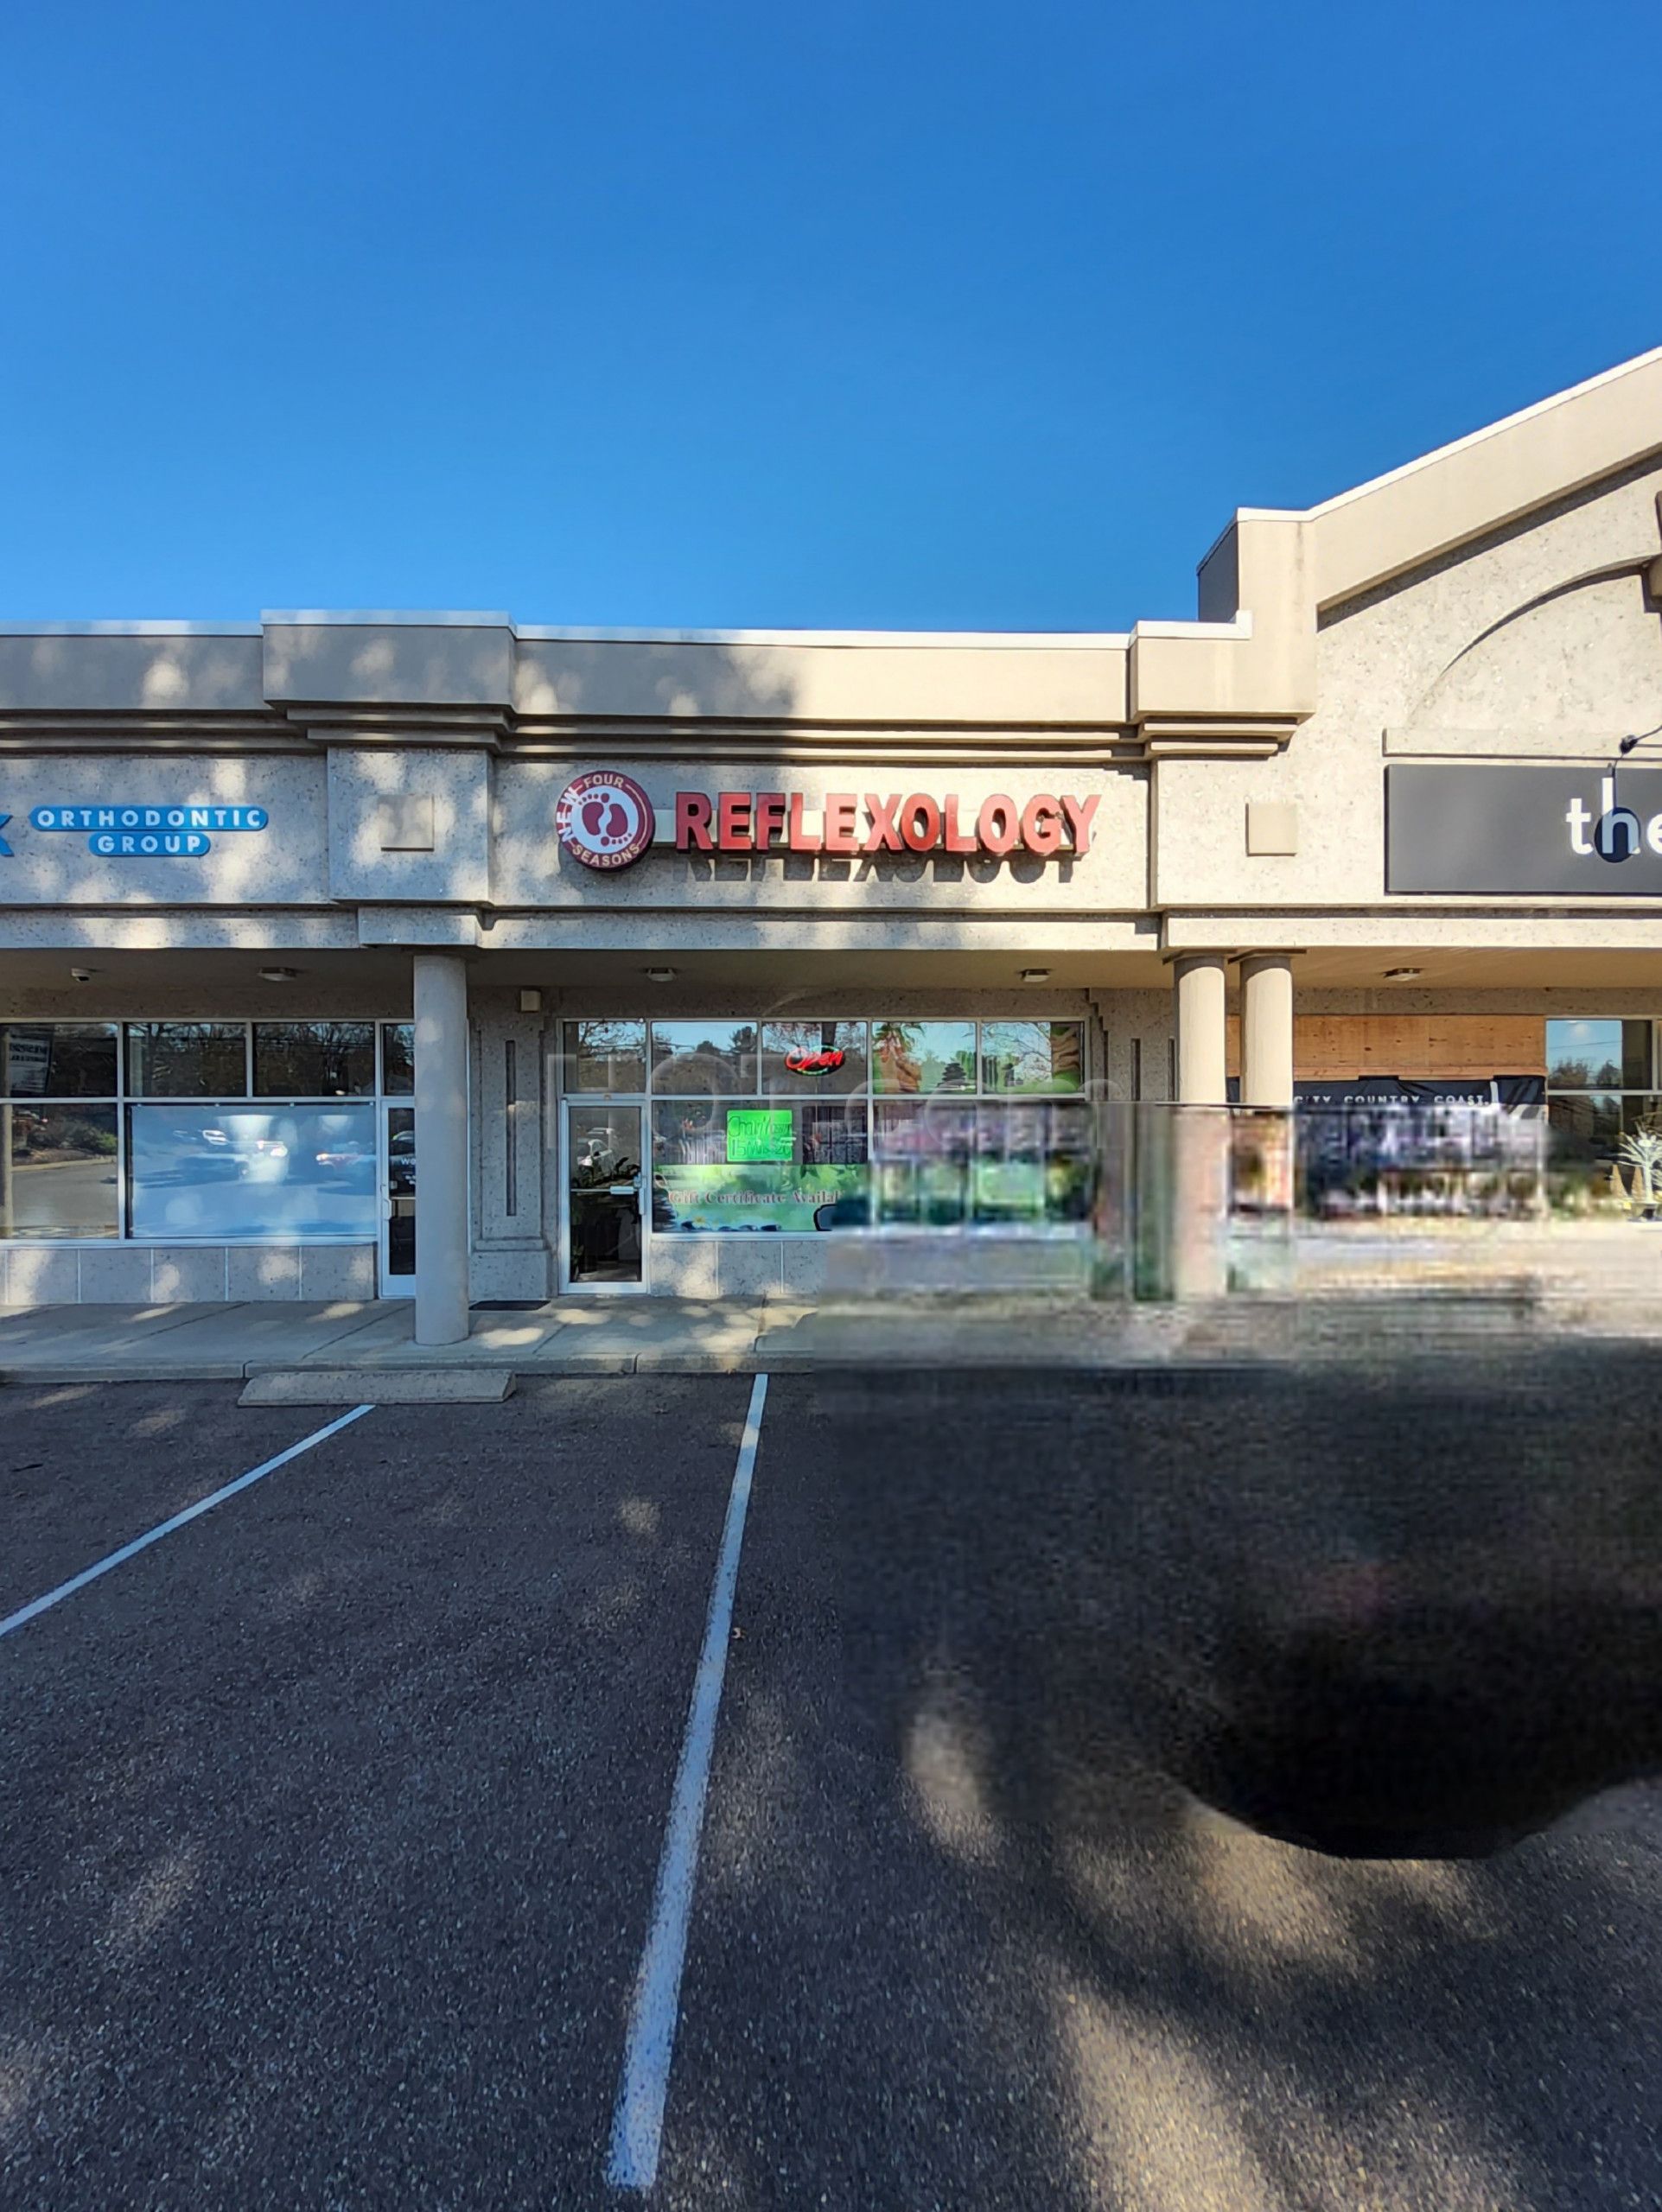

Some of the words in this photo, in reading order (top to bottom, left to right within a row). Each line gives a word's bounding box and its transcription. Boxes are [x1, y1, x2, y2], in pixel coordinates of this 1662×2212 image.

[584, 774, 624, 788] FOUR
[37, 810, 261, 827] ORTHODONTIC
[556, 786, 581, 842] NEW
[675, 791, 1102, 855] REFLEXOLOGY
[98, 836, 201, 852] GROUP
[572, 844, 640, 866] SEASONS
[705, 1190, 786, 1204] Certificate
